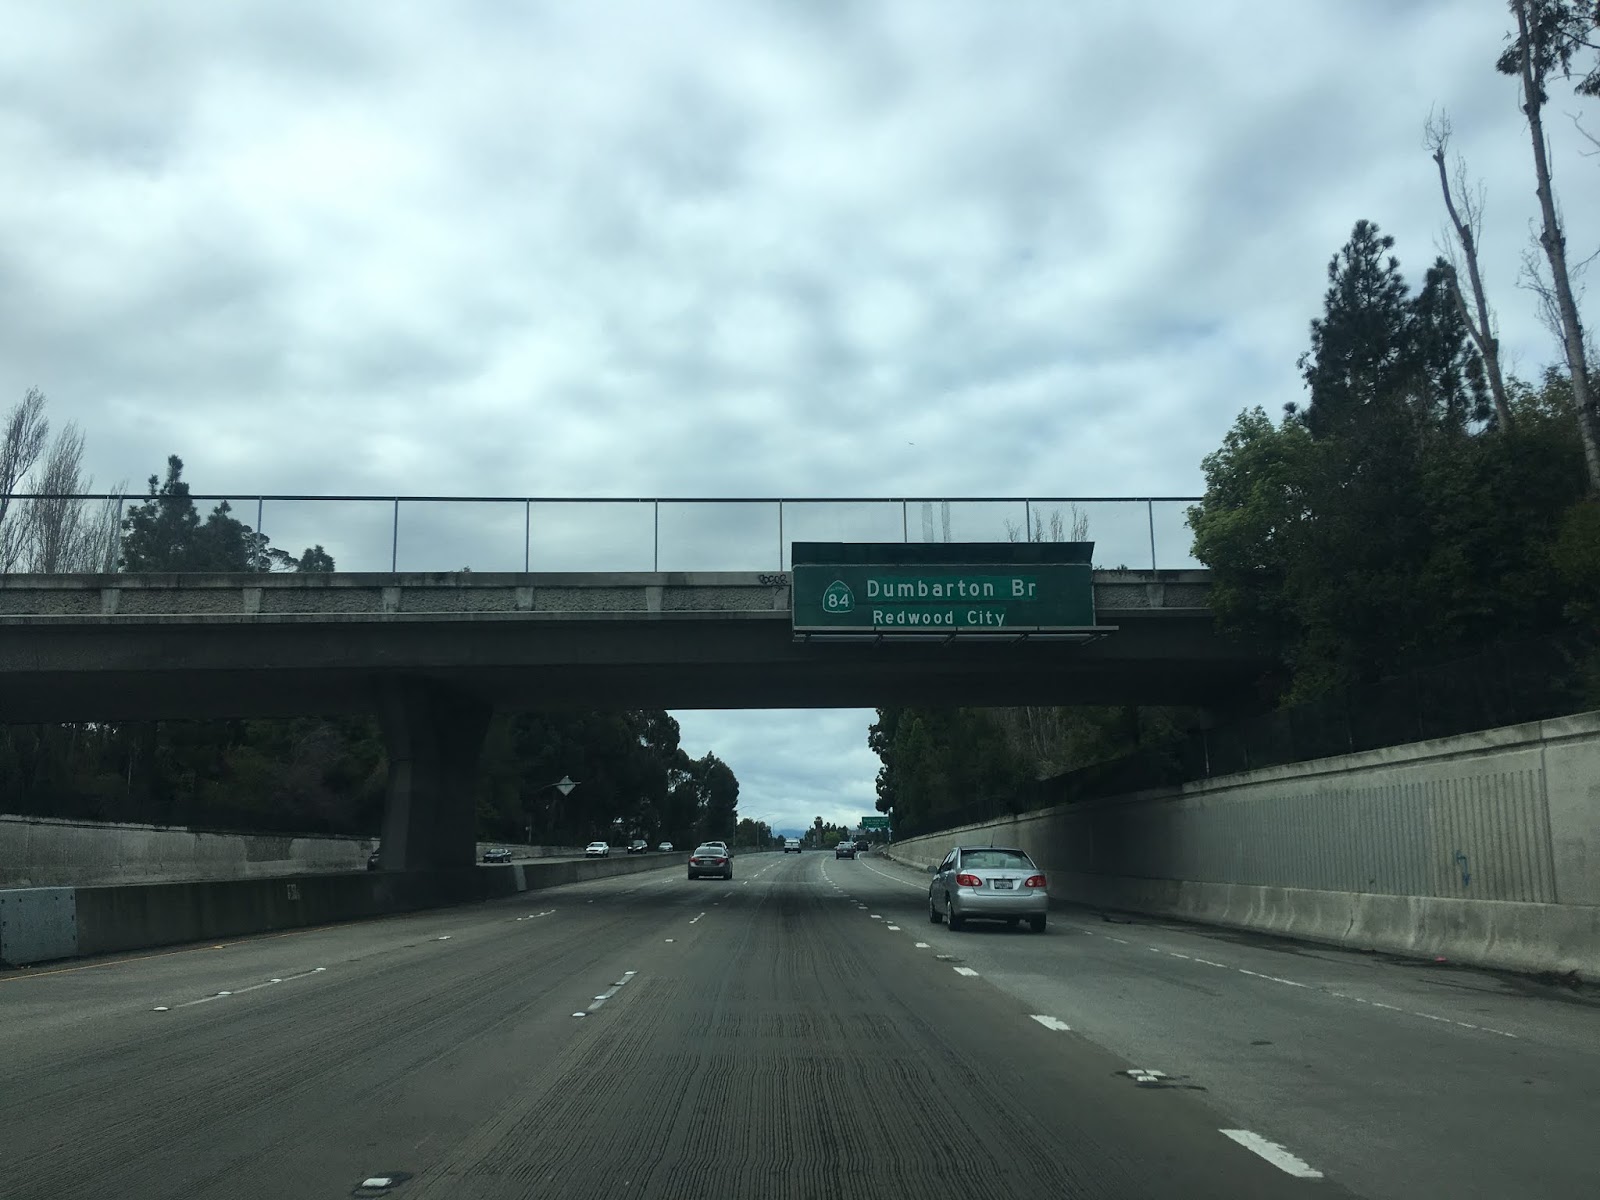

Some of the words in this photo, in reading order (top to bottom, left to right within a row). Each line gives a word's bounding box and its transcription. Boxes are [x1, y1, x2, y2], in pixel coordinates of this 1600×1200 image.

[867, 580, 994, 597] Dumbarton
[1011, 579, 1036, 597] Br
[828, 593, 850, 608] 84
[873, 610, 954, 625] Redwood
[967, 610, 1005, 627] City
